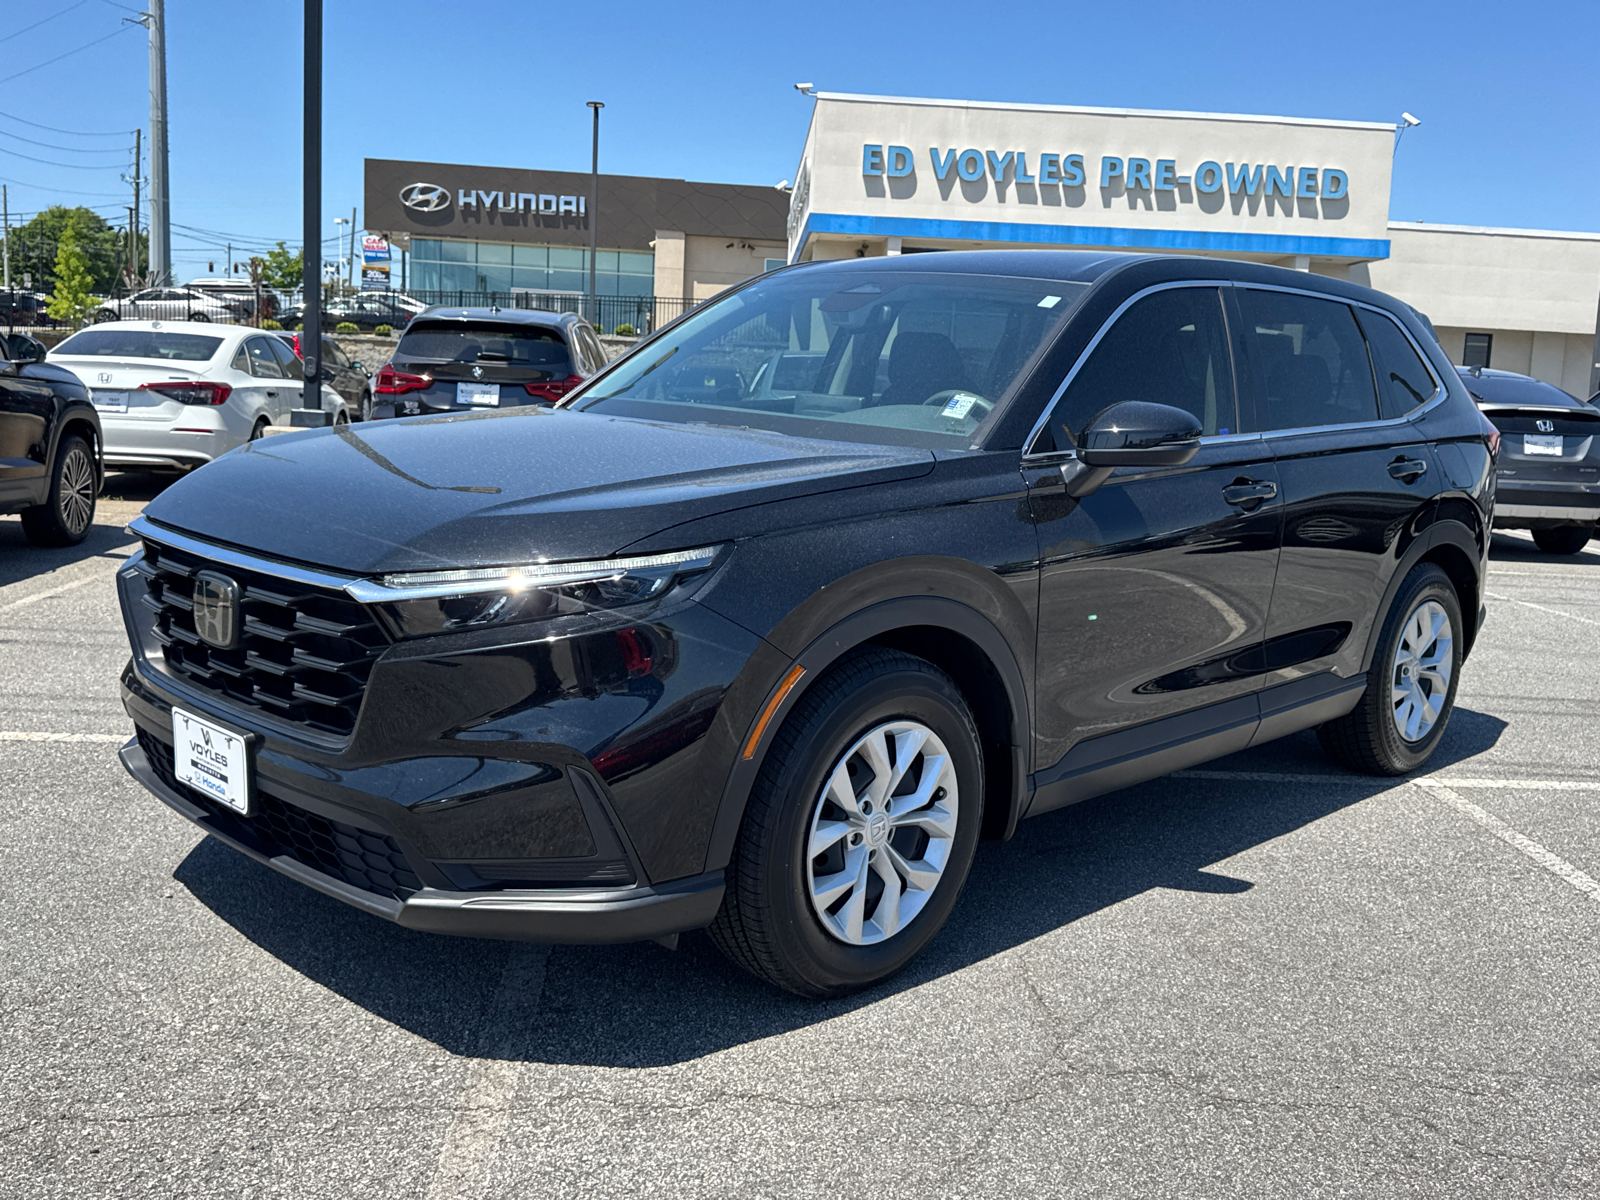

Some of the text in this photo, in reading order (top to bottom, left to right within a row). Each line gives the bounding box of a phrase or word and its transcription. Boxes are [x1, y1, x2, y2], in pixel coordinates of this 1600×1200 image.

[862, 144, 1350, 201] ED VOYLES PRE-OWNED
[458, 189, 586, 217] HYUNDAI
[190, 740, 228, 767] VOYLES
[202, 776, 225, 795] Honda
